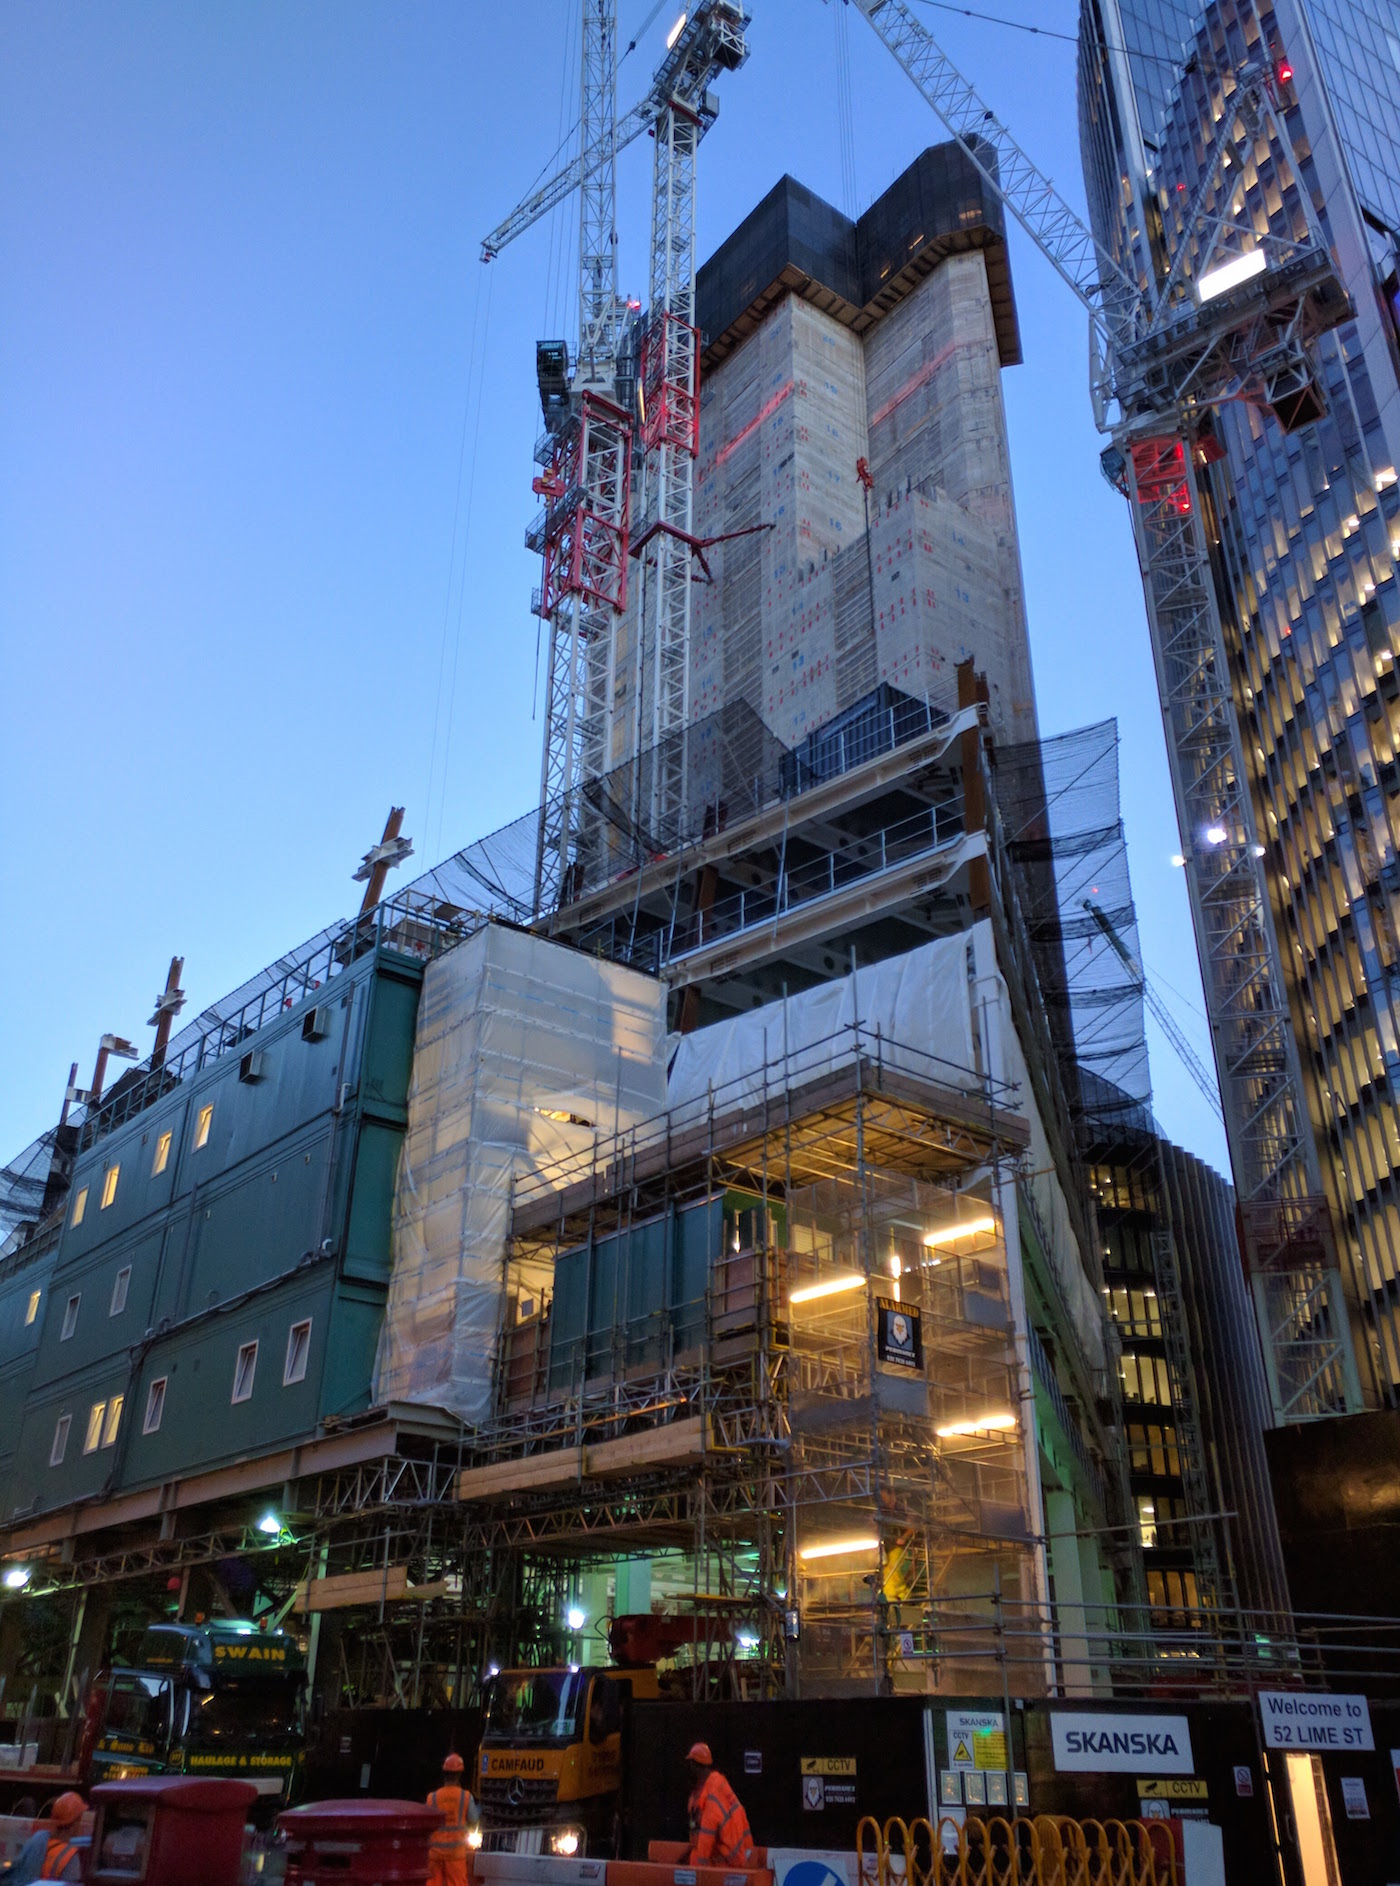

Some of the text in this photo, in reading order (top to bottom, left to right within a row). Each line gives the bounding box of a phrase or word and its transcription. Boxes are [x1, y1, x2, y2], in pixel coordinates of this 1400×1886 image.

[793, 712, 806, 725] 12
[880, 1298, 920, 1318] ALARMED
[215, 1645, 286, 1661] SWAIN
[1267, 1697, 1362, 1717] Welcome to
[959, 1718, 998, 1727] SKANSKA
[1274, 1725, 1364, 1745] 52 LIME ST
[1066, 1731, 1179, 1755] SKANSKA
[190, 1755, 237, 1767] HAULAGE
[239, 1755, 247, 1767] &
[250, 1755, 292, 1767] STORAGE
[491, 1758, 544, 1771] CAMFAUD
[827, 1759, 851, 1771] CCTV
[1172, 1781, 1201, 1793] CCTV
